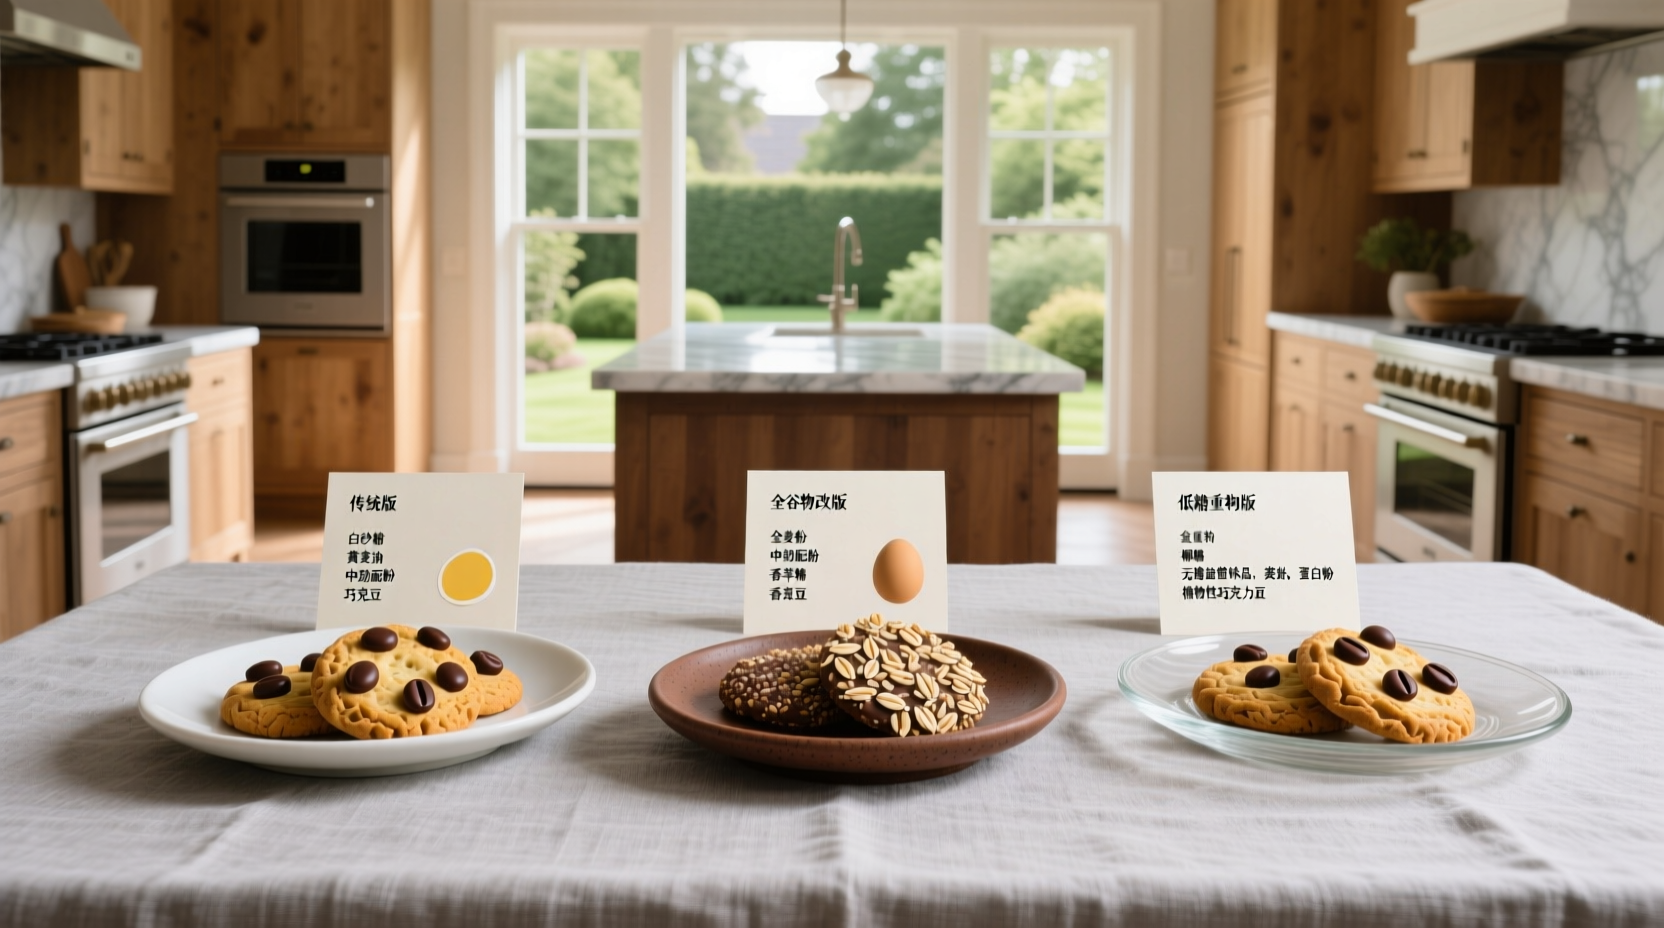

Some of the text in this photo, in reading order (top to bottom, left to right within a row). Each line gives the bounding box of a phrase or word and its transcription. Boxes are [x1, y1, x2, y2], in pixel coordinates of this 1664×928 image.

[349, 494, 397, 512] 传统版
[770, 493, 848, 511] 全谷物改版
